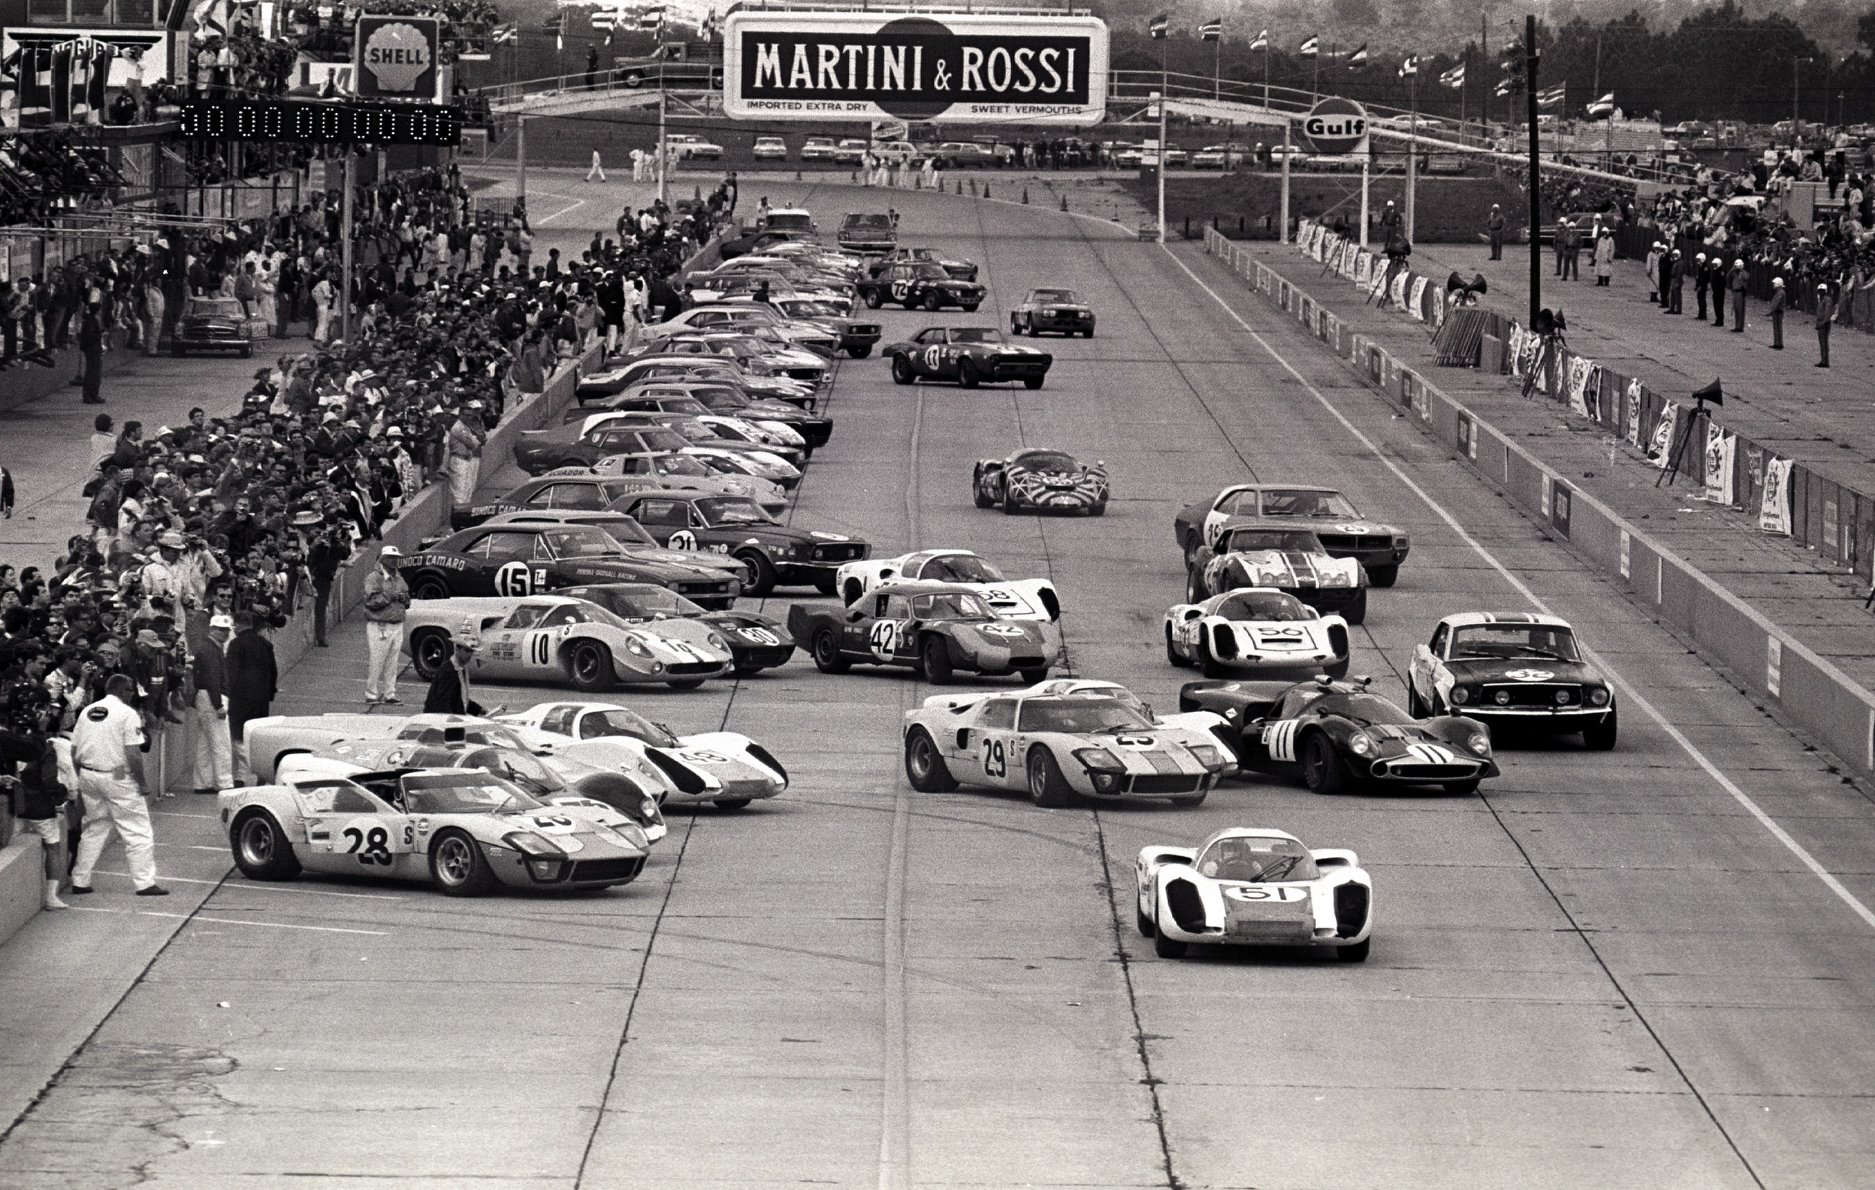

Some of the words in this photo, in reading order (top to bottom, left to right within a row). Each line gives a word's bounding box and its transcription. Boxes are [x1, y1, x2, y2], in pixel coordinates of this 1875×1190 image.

[370, 48, 424, 64] SHELL
[753, 43, 924, 91] MARTINI
[934, 59, 952, 90] &
[961, 47, 1076, 93] ROSSI
[747, 101, 802, 110] IMPORTED
[806, 102, 841, 110] EXTRA
[846, 103, 868, 111] DRY
[971, 105, 1010, 113] SWEET
[1015, 106, 1082, 114] VERMOUTHS
[1306, 118, 1365, 135] Gulf
[894, 282, 907, 297] 72
[398, 556, 424, 568] UNOCO
[426, 554, 466, 571] CAMARO
[501, 566, 529, 597] 15
[870, 622, 894, 654] 42
[1257, 628, 1303, 636] 56
[531, 633, 549, 664] 10
[1276, 721, 1292, 759] 11
[679, 752, 728, 763] 48
[983, 737, 1006, 778] 29
[1010, 740, 1015, 756] S
[1415, 745, 1447, 763] 11
[343, 826, 392, 866] 28
[404, 826, 413, 845] S
[1239, 887, 1287, 901] 51
